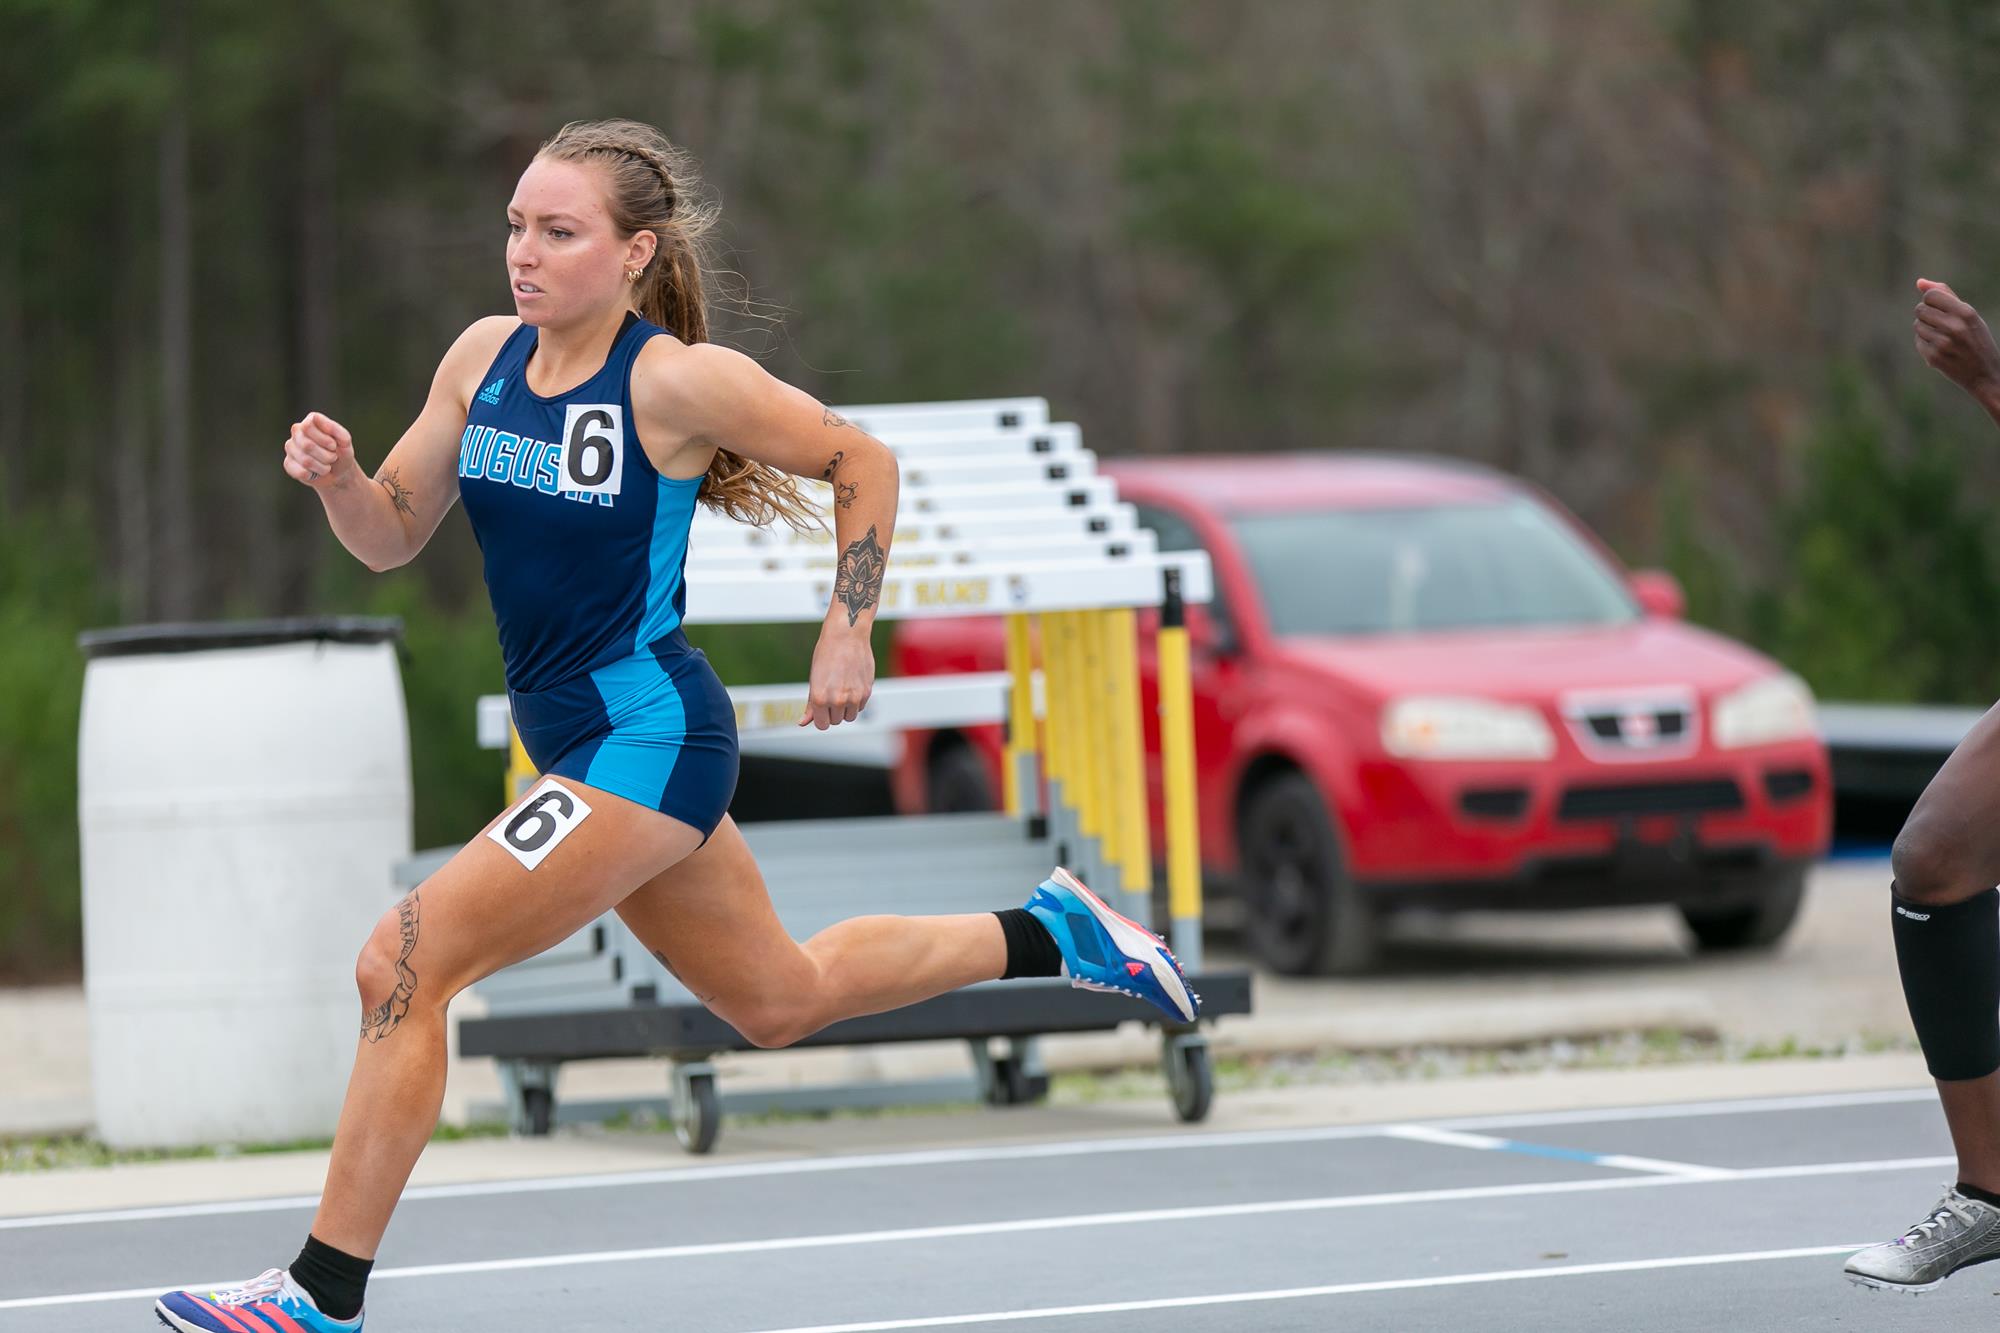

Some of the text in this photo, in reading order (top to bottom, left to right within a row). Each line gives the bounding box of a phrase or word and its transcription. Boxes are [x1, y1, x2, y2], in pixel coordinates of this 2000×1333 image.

[458, 424, 614, 508] UGUS
[567, 409, 615, 487] 6
[504, 790, 574, 852] 6
